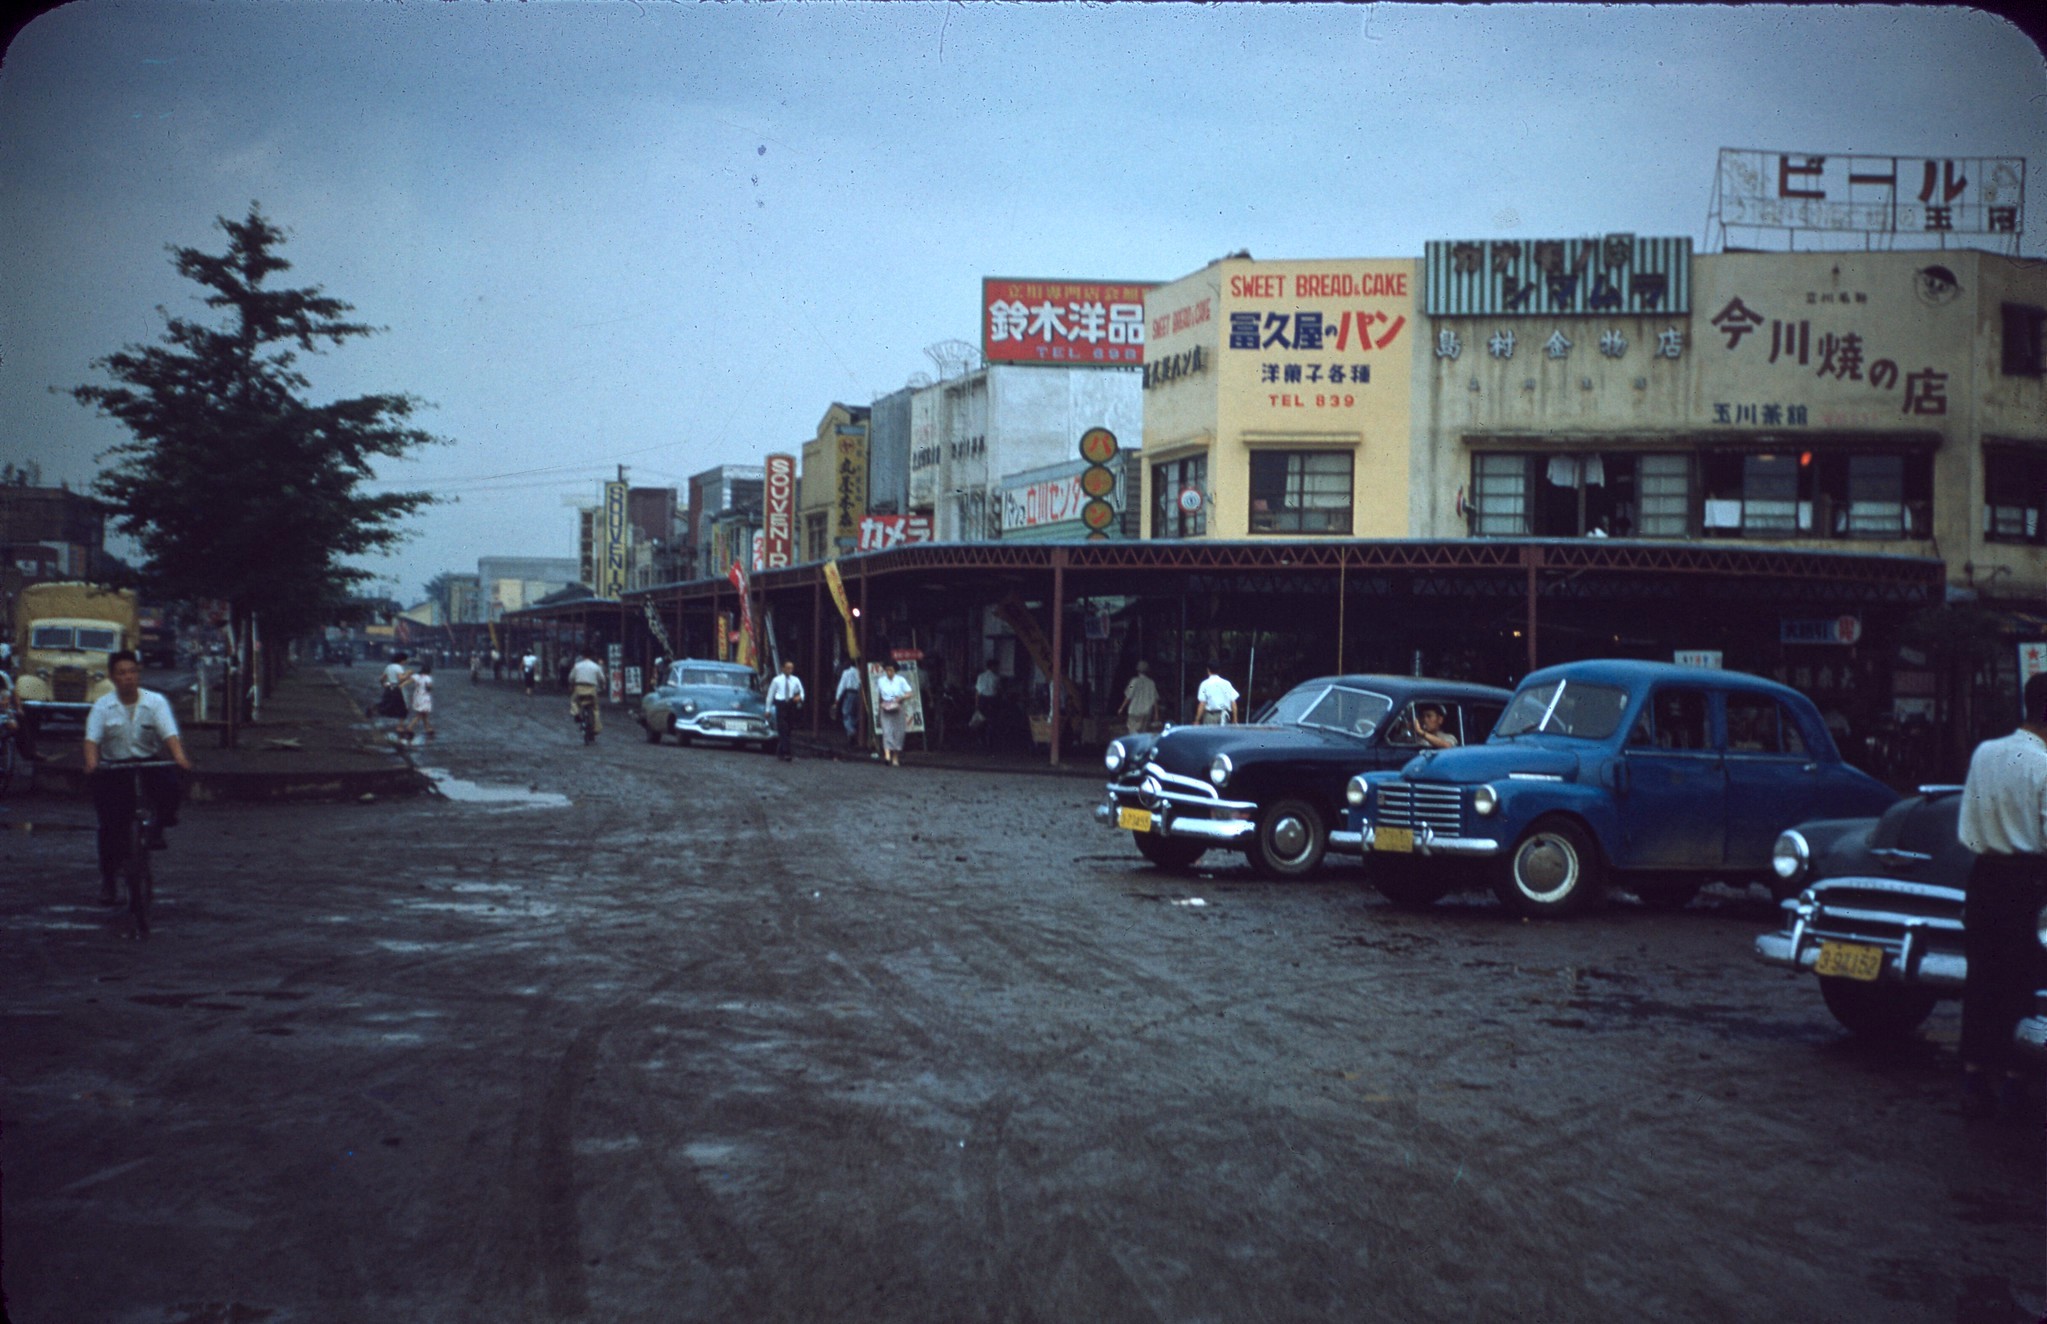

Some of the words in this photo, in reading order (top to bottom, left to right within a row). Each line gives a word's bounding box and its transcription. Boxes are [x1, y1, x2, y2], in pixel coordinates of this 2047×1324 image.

[1779, 155, 1968, 204] ビール
[1230, 275, 1285, 299] SWEET
[1435, 327, 1684, 361] 島村金物店
[1711, 294, 1949, 416] 今川焼の店
[1261, 364, 1371, 384] 洋菓子各種
[1268, 394, 1305, 409] TEL
[1315, 394, 1355, 409] 839
[768, 458, 790, 569] SOUVENIR
[607, 486, 624, 598] SOUVENIR
[861, 517, 931, 551] カメラ
